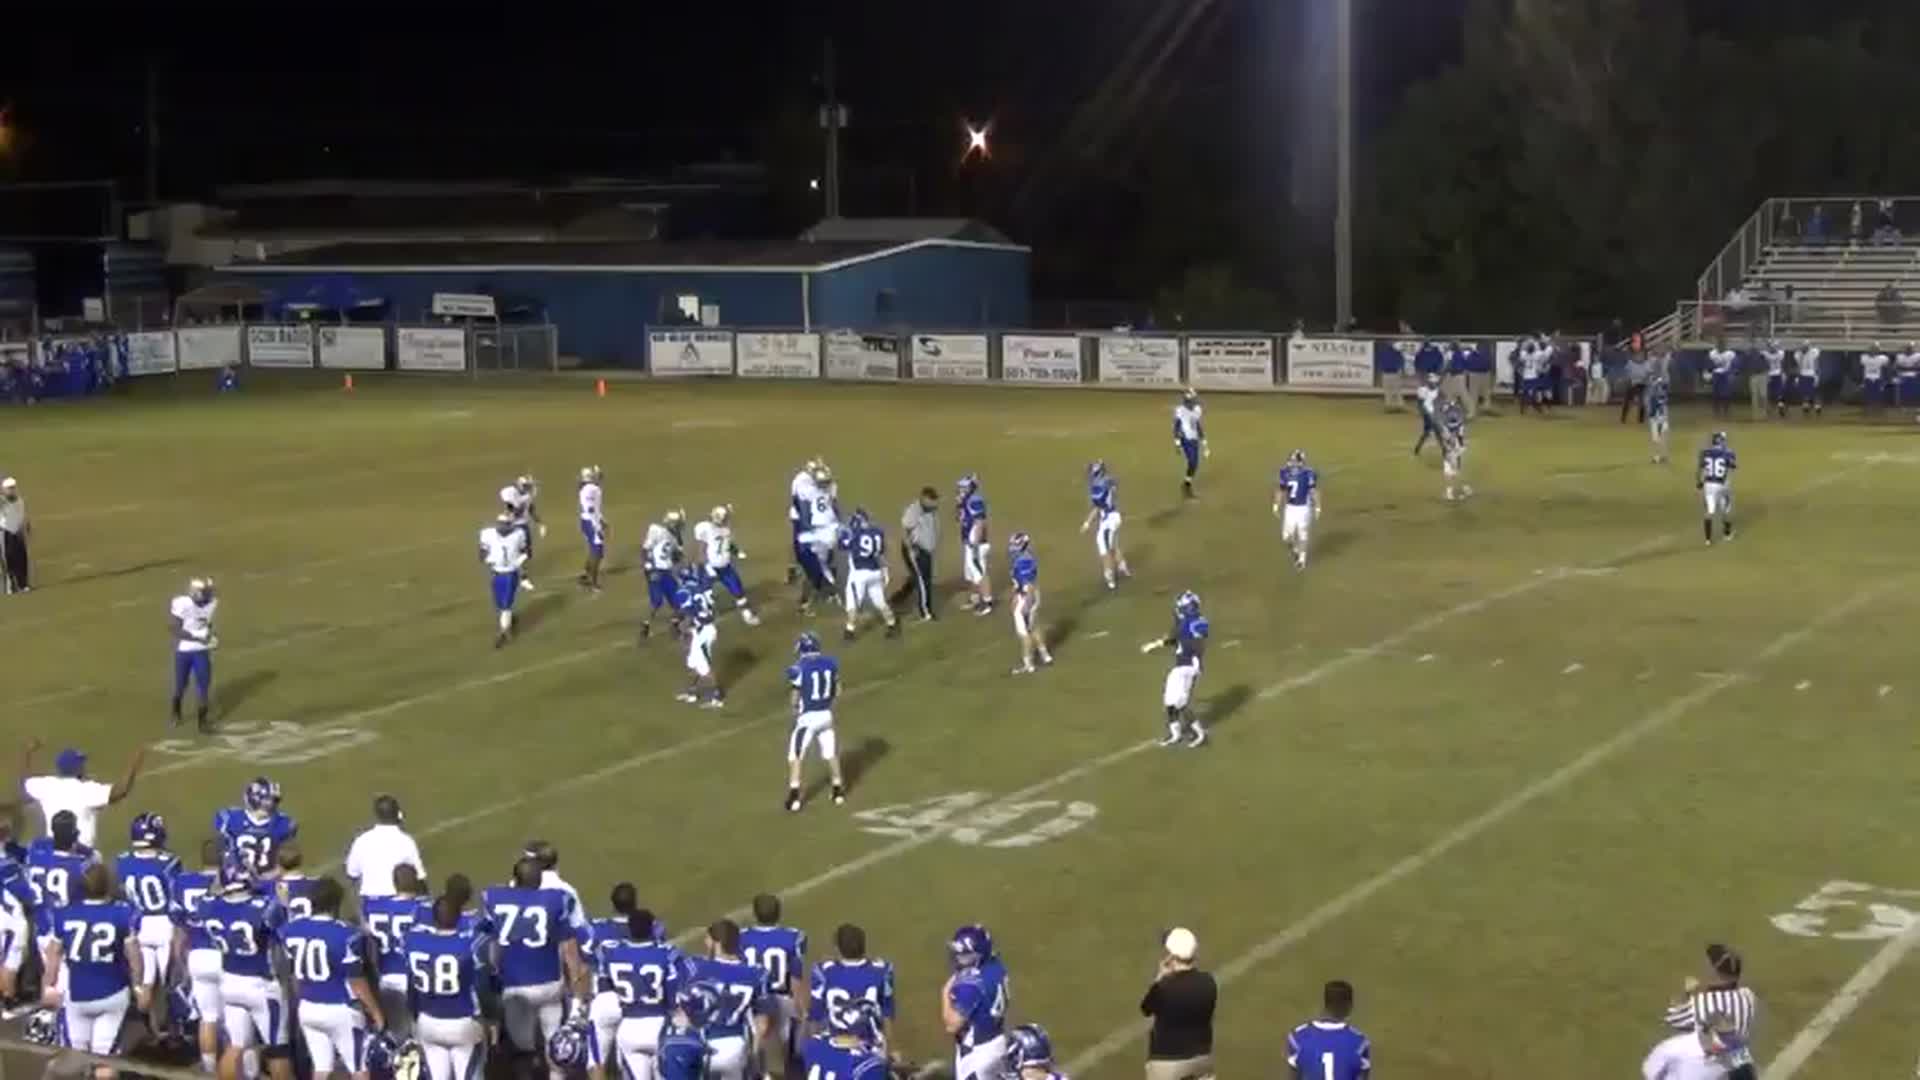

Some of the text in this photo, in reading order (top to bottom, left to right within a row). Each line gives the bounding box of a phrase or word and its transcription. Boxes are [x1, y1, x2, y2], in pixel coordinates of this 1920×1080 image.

[1287, 481, 1300, 499] 7
[860, 535, 881, 557] 91
[811, 670, 832, 700] 11
[236, 834, 271, 867] 61
[29, 866, 69, 908] 59
[62, 919, 116, 963] 72
[205, 919, 257, 956] 63
[494, 904, 547, 948] 73
[286, 936, 331, 981] 70
[408, 951, 460, 996] 58
[744, 946, 789, 989] 10
[609, 962, 664, 1005] 53
